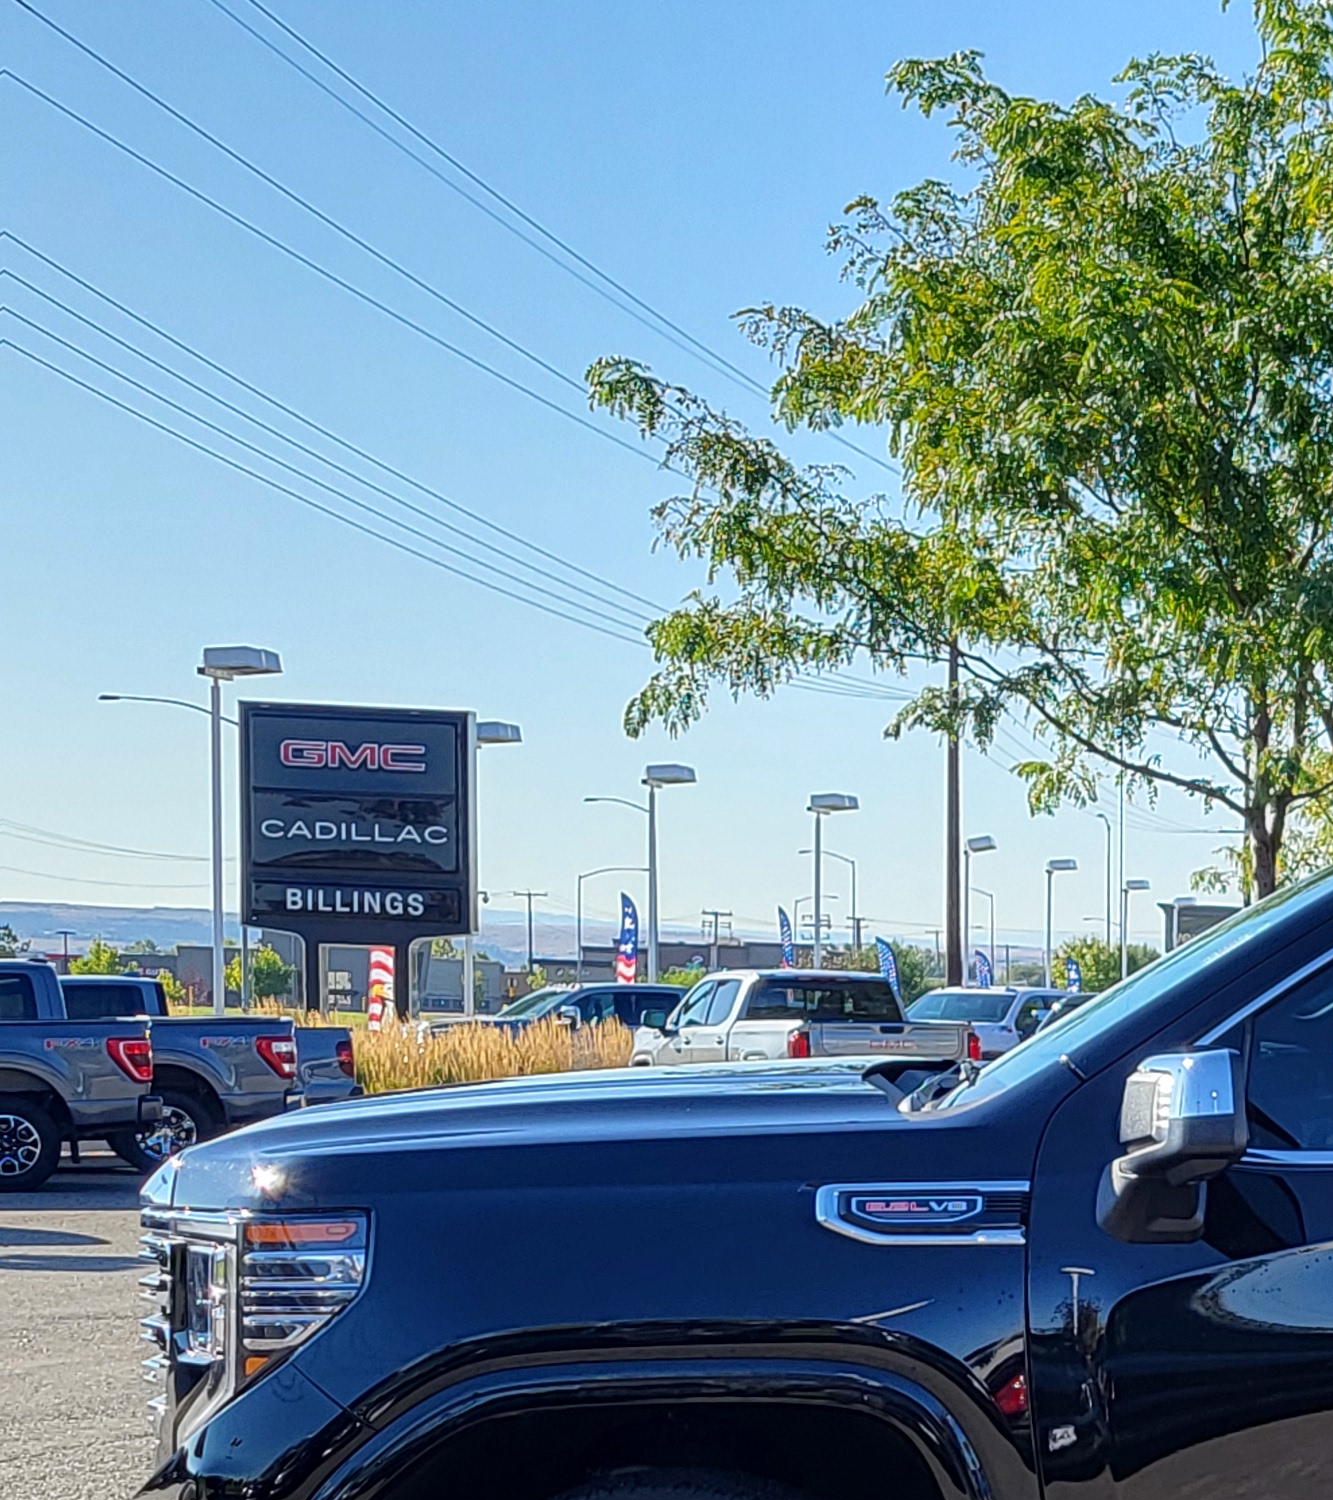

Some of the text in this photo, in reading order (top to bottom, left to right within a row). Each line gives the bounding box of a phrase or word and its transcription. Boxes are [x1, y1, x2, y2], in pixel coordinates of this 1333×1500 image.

[280, 739, 426, 772] GMC
[261, 819, 448, 844] CADILLAC
[286, 888, 424, 915] BILLINGS
